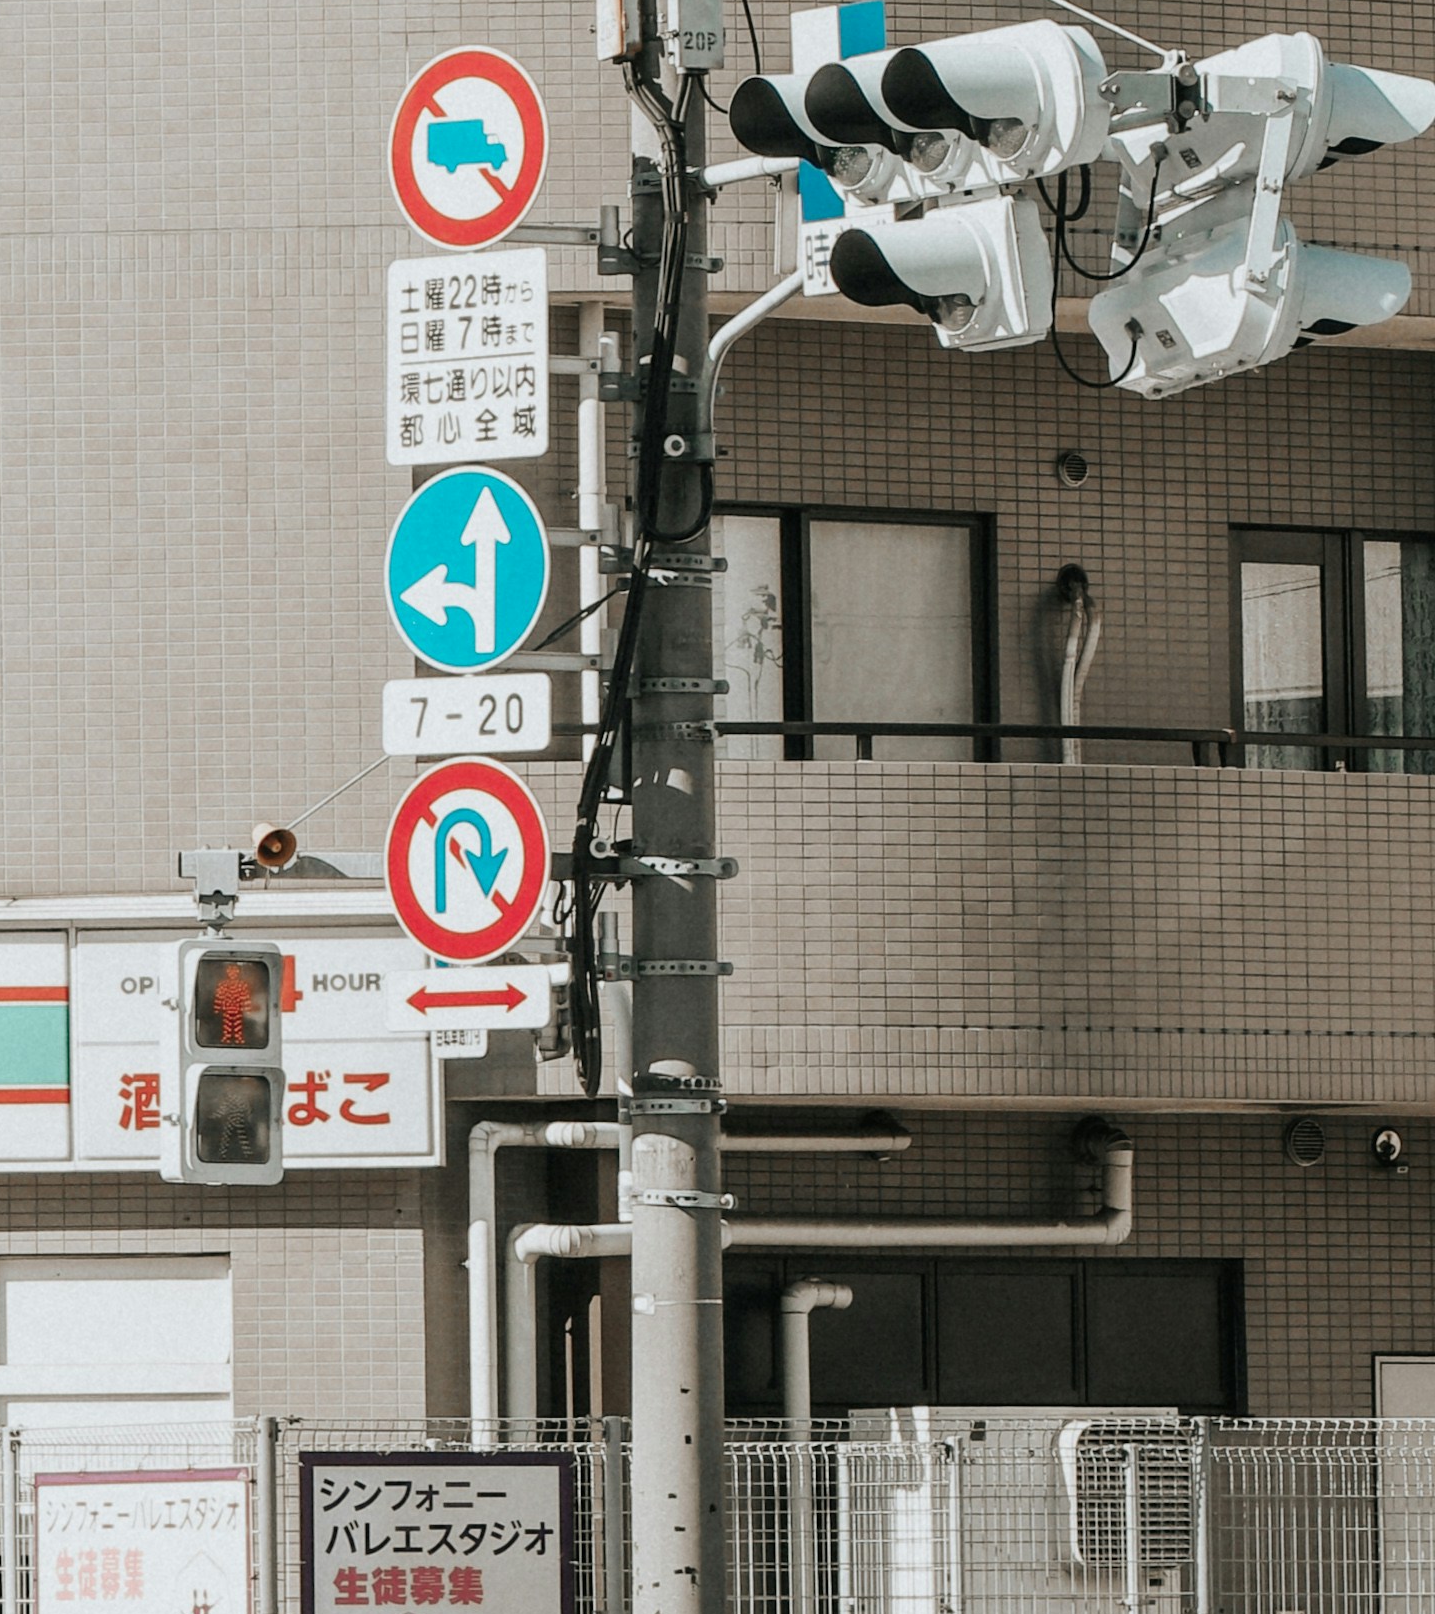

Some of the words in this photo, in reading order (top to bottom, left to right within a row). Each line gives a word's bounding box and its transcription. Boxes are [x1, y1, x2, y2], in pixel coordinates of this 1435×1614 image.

[683, 31, 717, 52] 20P
[400, 274, 534, 314] 土曜22時から
[400, 314, 535, 354] 日曜7時まで
[399, 363, 536, 405] 環七通り以内
[399, 404, 537, 448] 都心全域
[120, 976, 160, 995] OP
[319, 1477, 508, 1513] シンフォニー
[324, 1519, 554, 1557] バレエスタジオ
[54, 1545, 145, 1602] 生徒募集
[332, 1565, 485, 1607] 生徒募集
